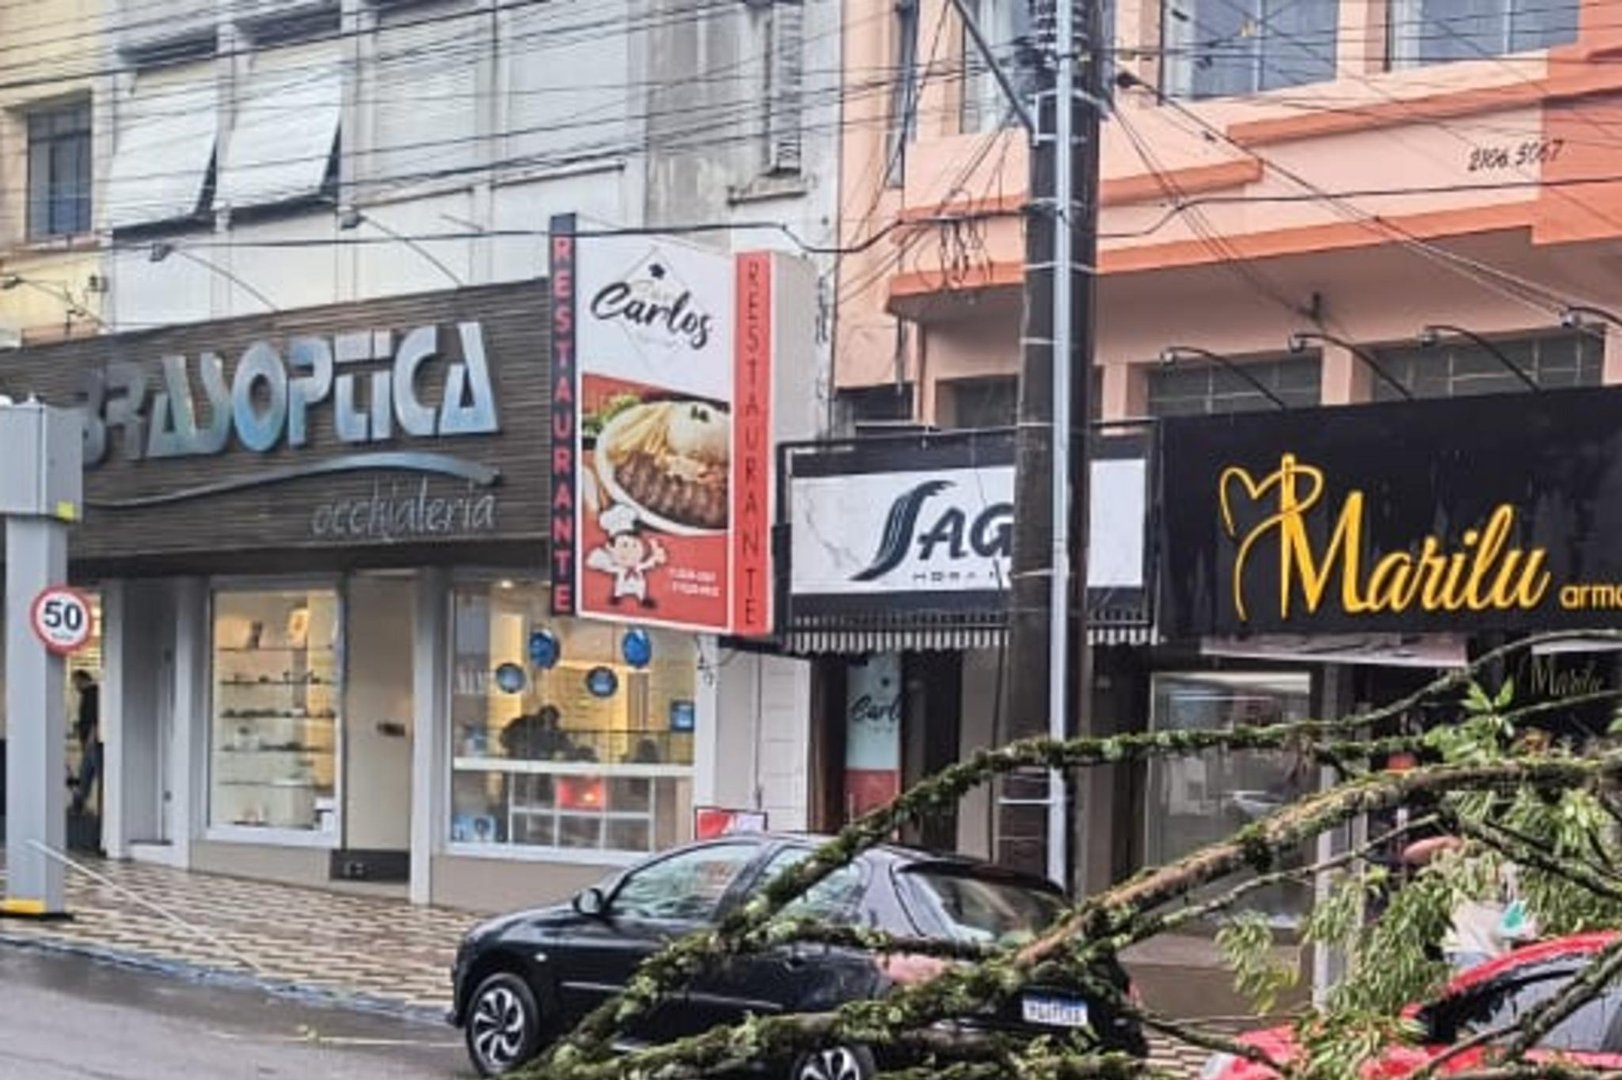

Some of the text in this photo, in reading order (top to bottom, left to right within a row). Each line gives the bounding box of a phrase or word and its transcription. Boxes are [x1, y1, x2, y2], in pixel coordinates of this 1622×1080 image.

[590, 281, 712, 350] Carlos
[553, 235, 573, 611] RESTAURANTE
[743, 262, 760, 626] RESTAURANTE
[849, 479, 1013, 582] SAG
[1279, 453, 1552, 621] Marilu
[44, 601, 83, 631] 50
